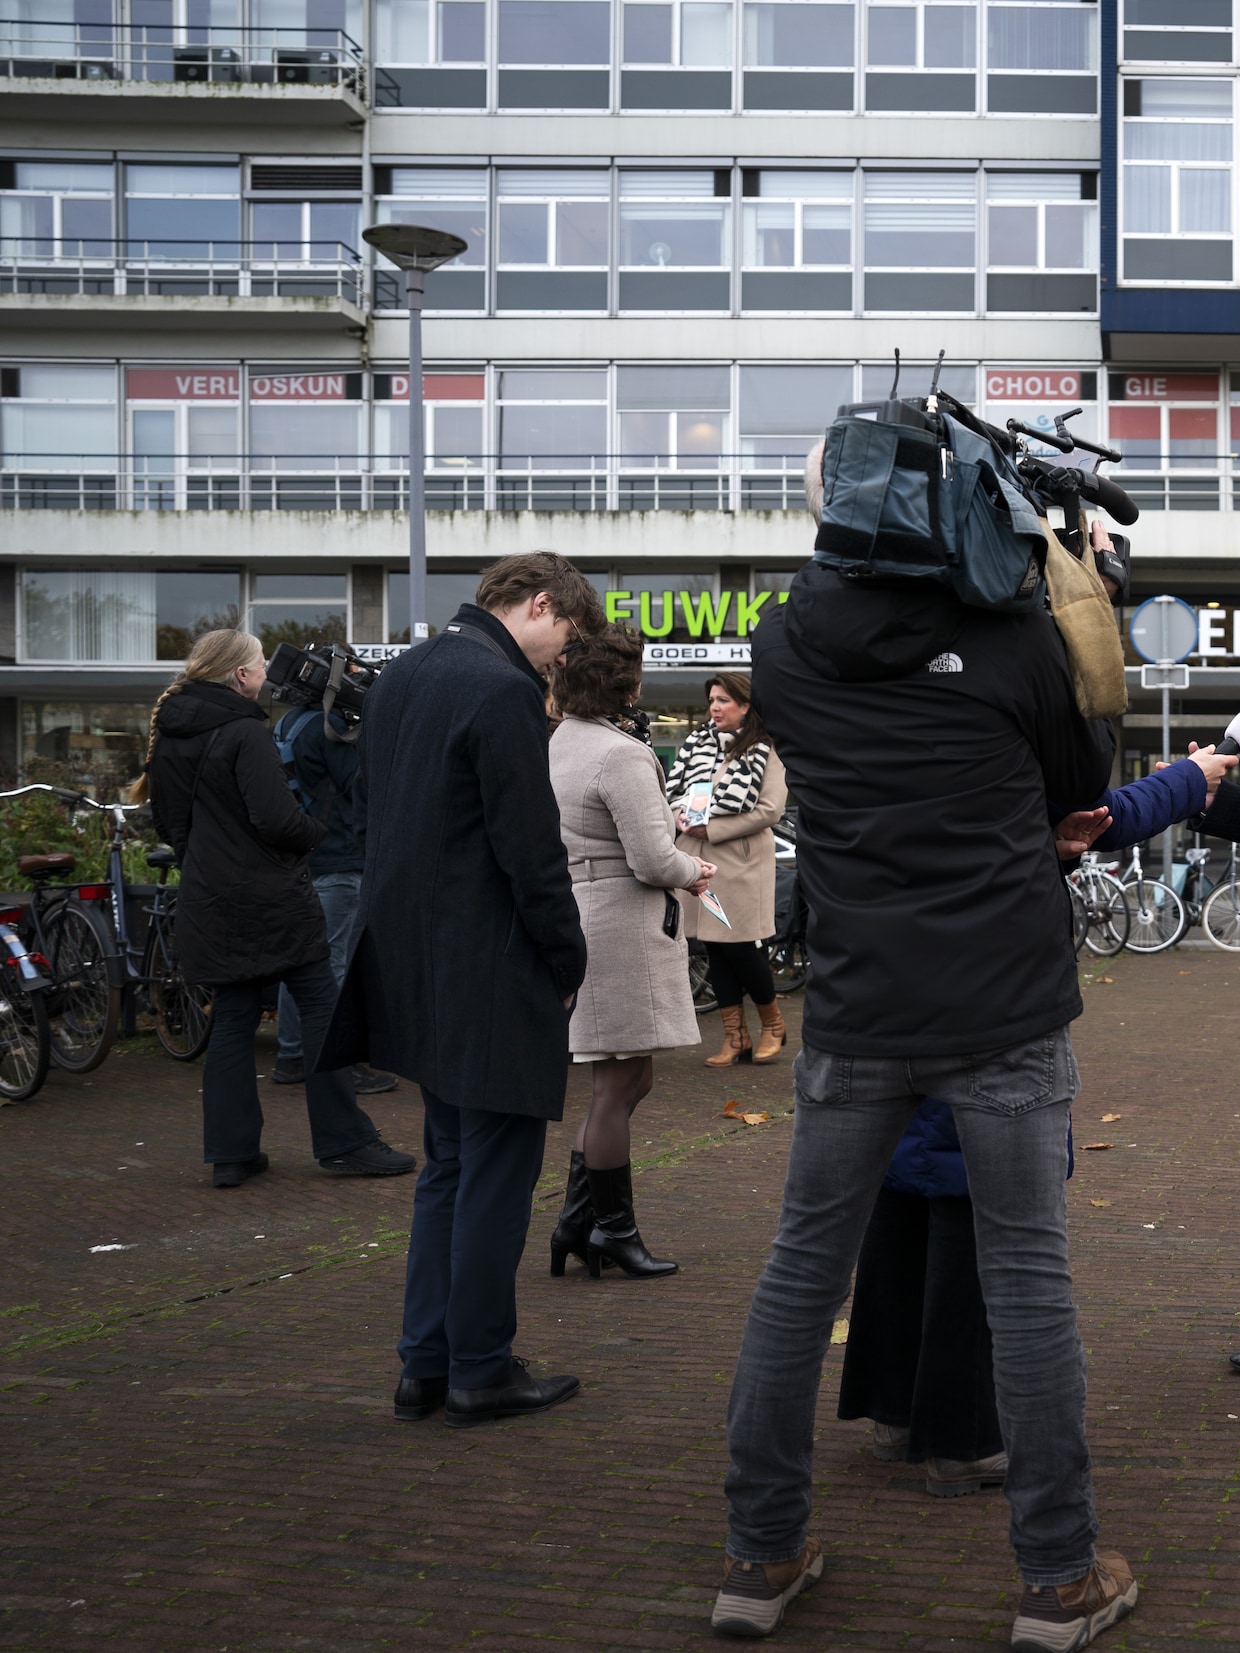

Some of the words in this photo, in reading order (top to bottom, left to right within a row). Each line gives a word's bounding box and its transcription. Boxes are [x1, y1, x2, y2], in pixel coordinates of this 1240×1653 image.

[605, 590, 790, 637] EUWK
[651, 648, 708, 658] GOED
[929, 665, 949, 673] FACE
